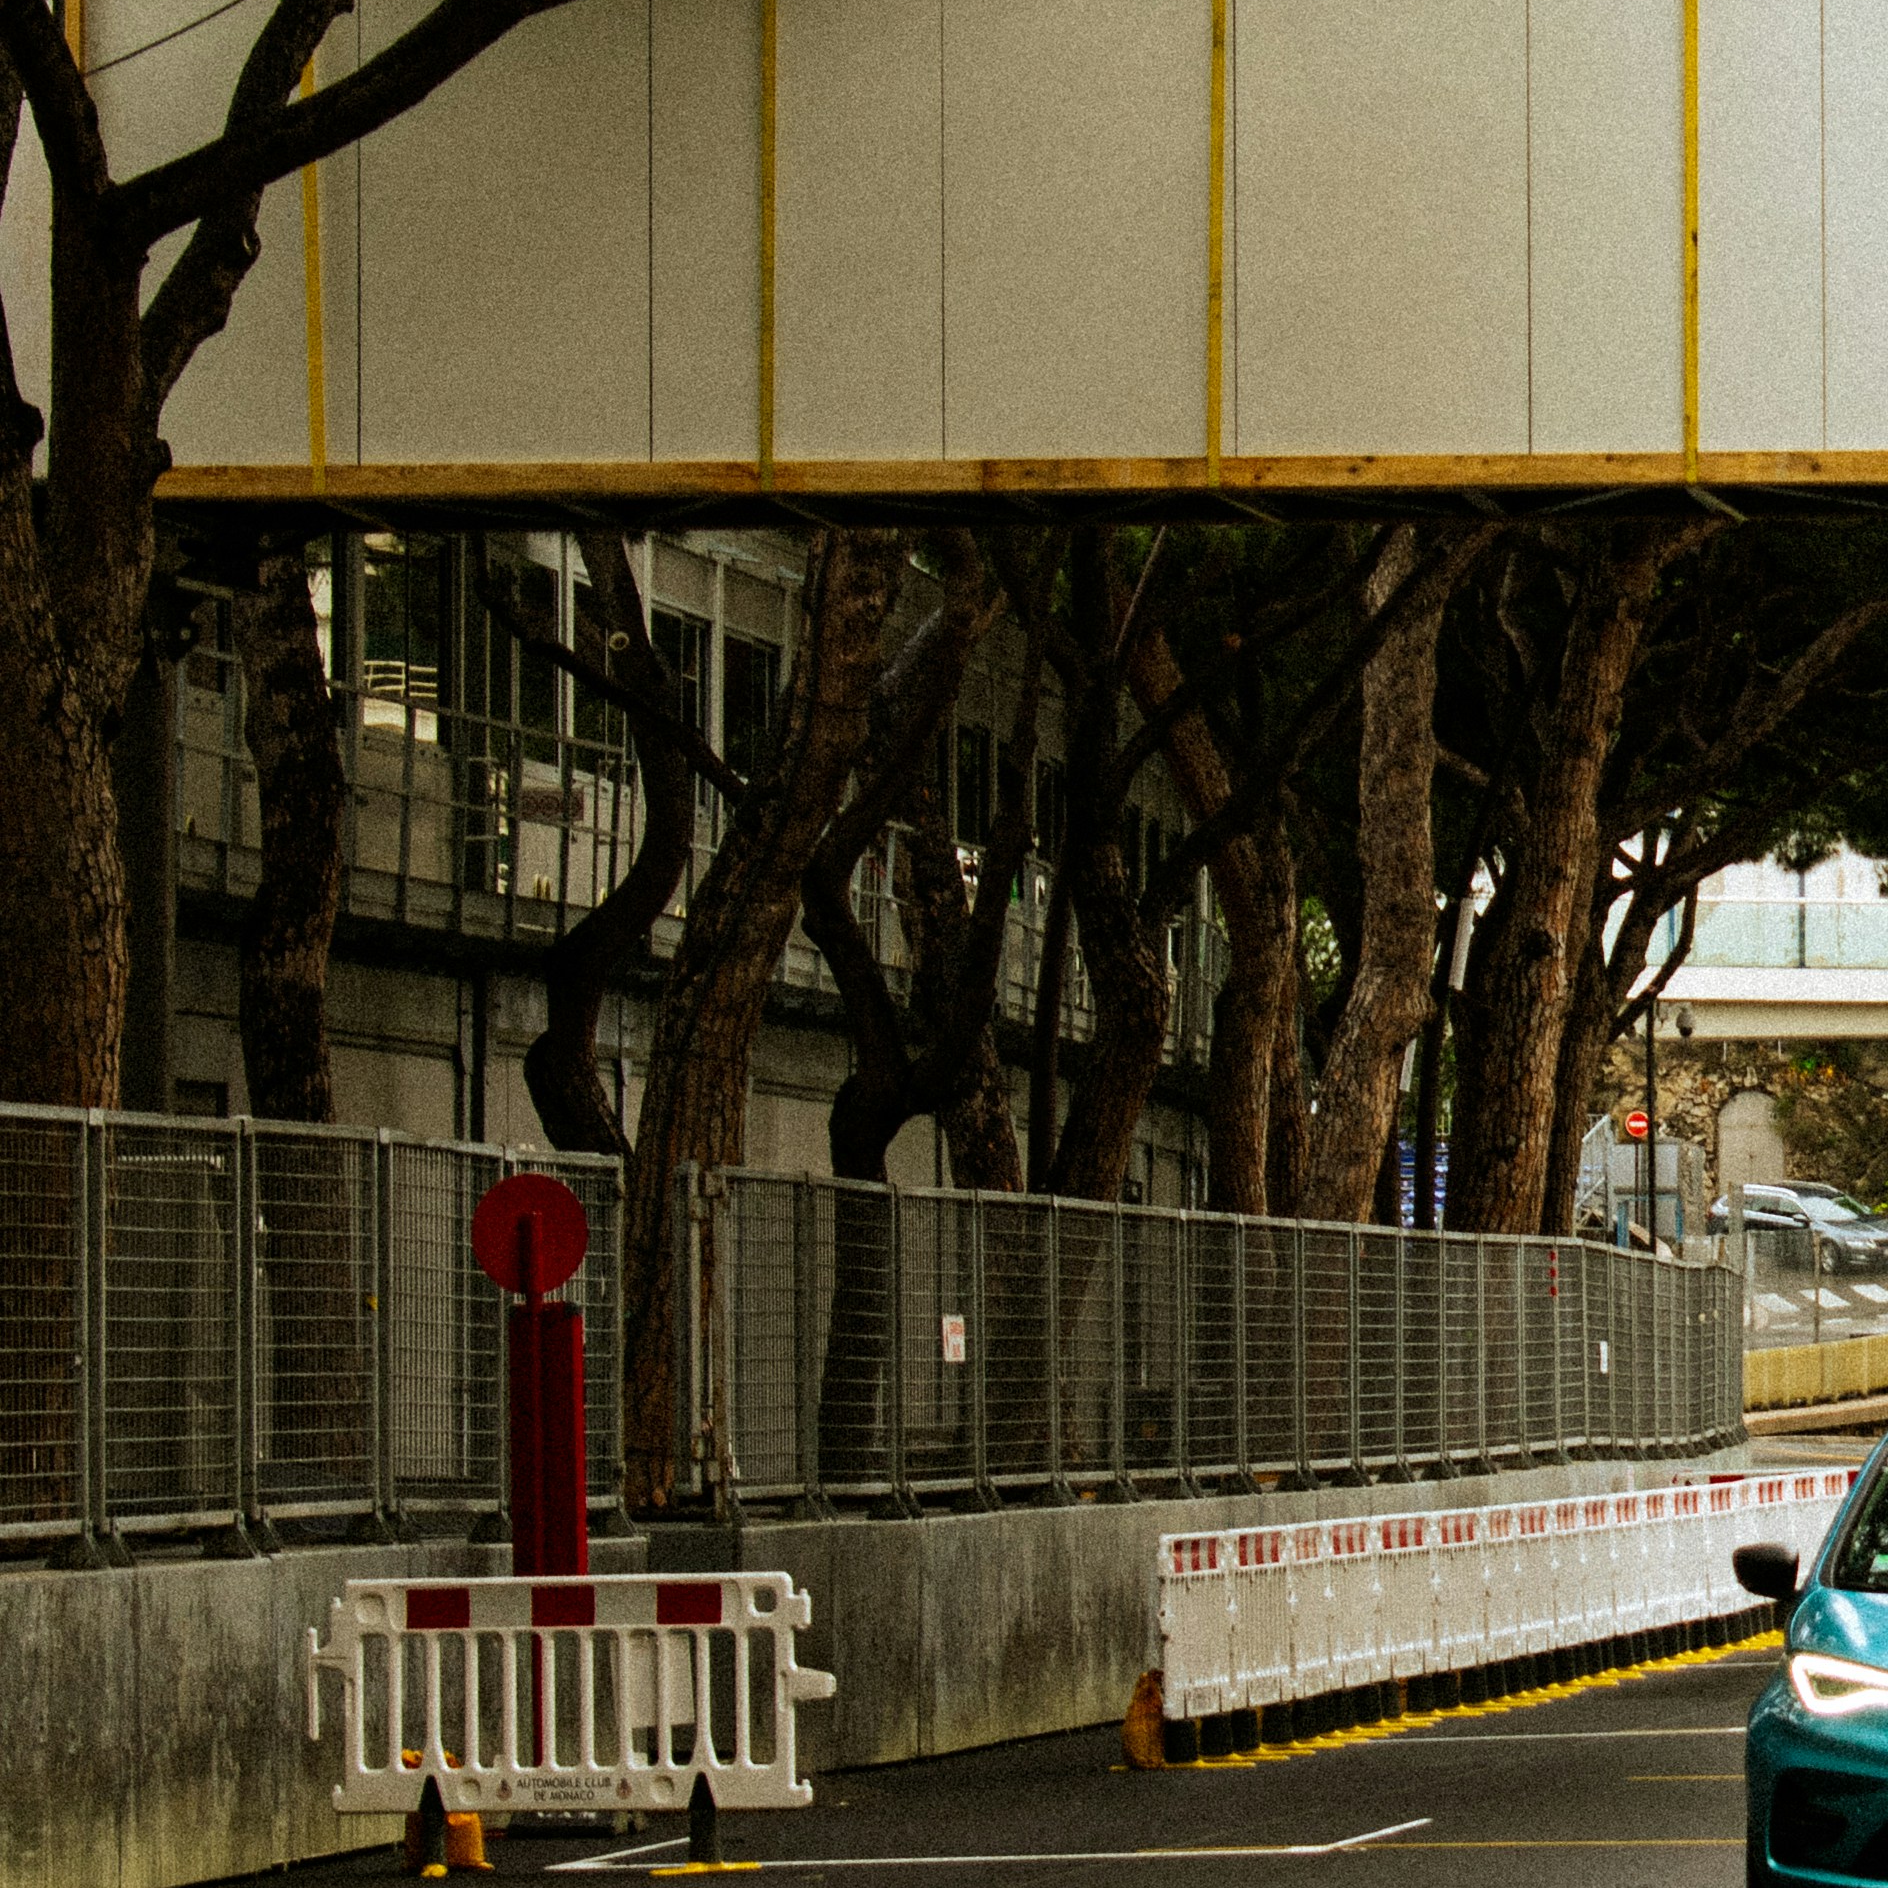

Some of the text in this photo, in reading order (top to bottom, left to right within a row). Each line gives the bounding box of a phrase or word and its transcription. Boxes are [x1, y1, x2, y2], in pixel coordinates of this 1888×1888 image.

[516, 1776, 612, 1789] AUTOMOBILE CLUB
[533, 1790, 595, 1802] DE MONACO
